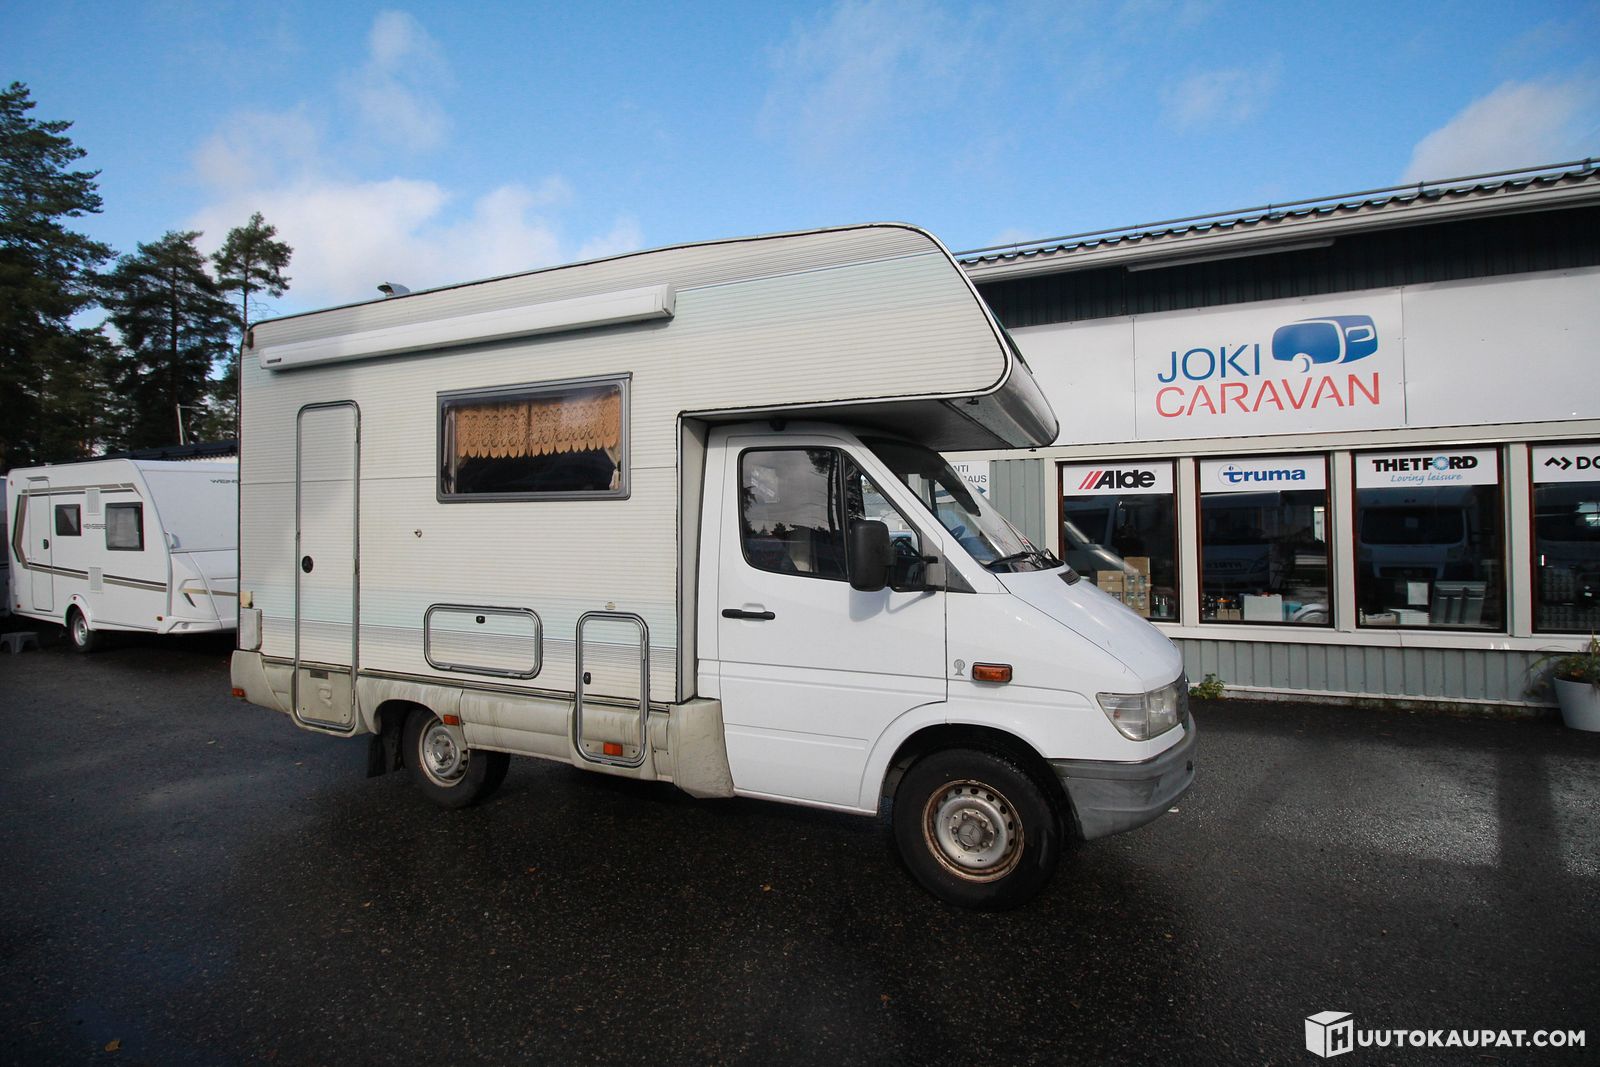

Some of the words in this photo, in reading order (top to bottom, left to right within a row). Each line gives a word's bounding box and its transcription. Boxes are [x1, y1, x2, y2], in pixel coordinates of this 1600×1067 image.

[1157, 343, 1260, 384] JOKI
[1155, 372, 1380, 418] CARAVAN
[1372, 456, 1478, 472] THETFORD
[964, 474, 987, 483] AUS
[1093, 469, 1156, 490] Alde
[1223, 466, 1306, 483] truma
[1391, 474, 1425, 485] Loving
[1427, 472, 1464, 481] leisure
